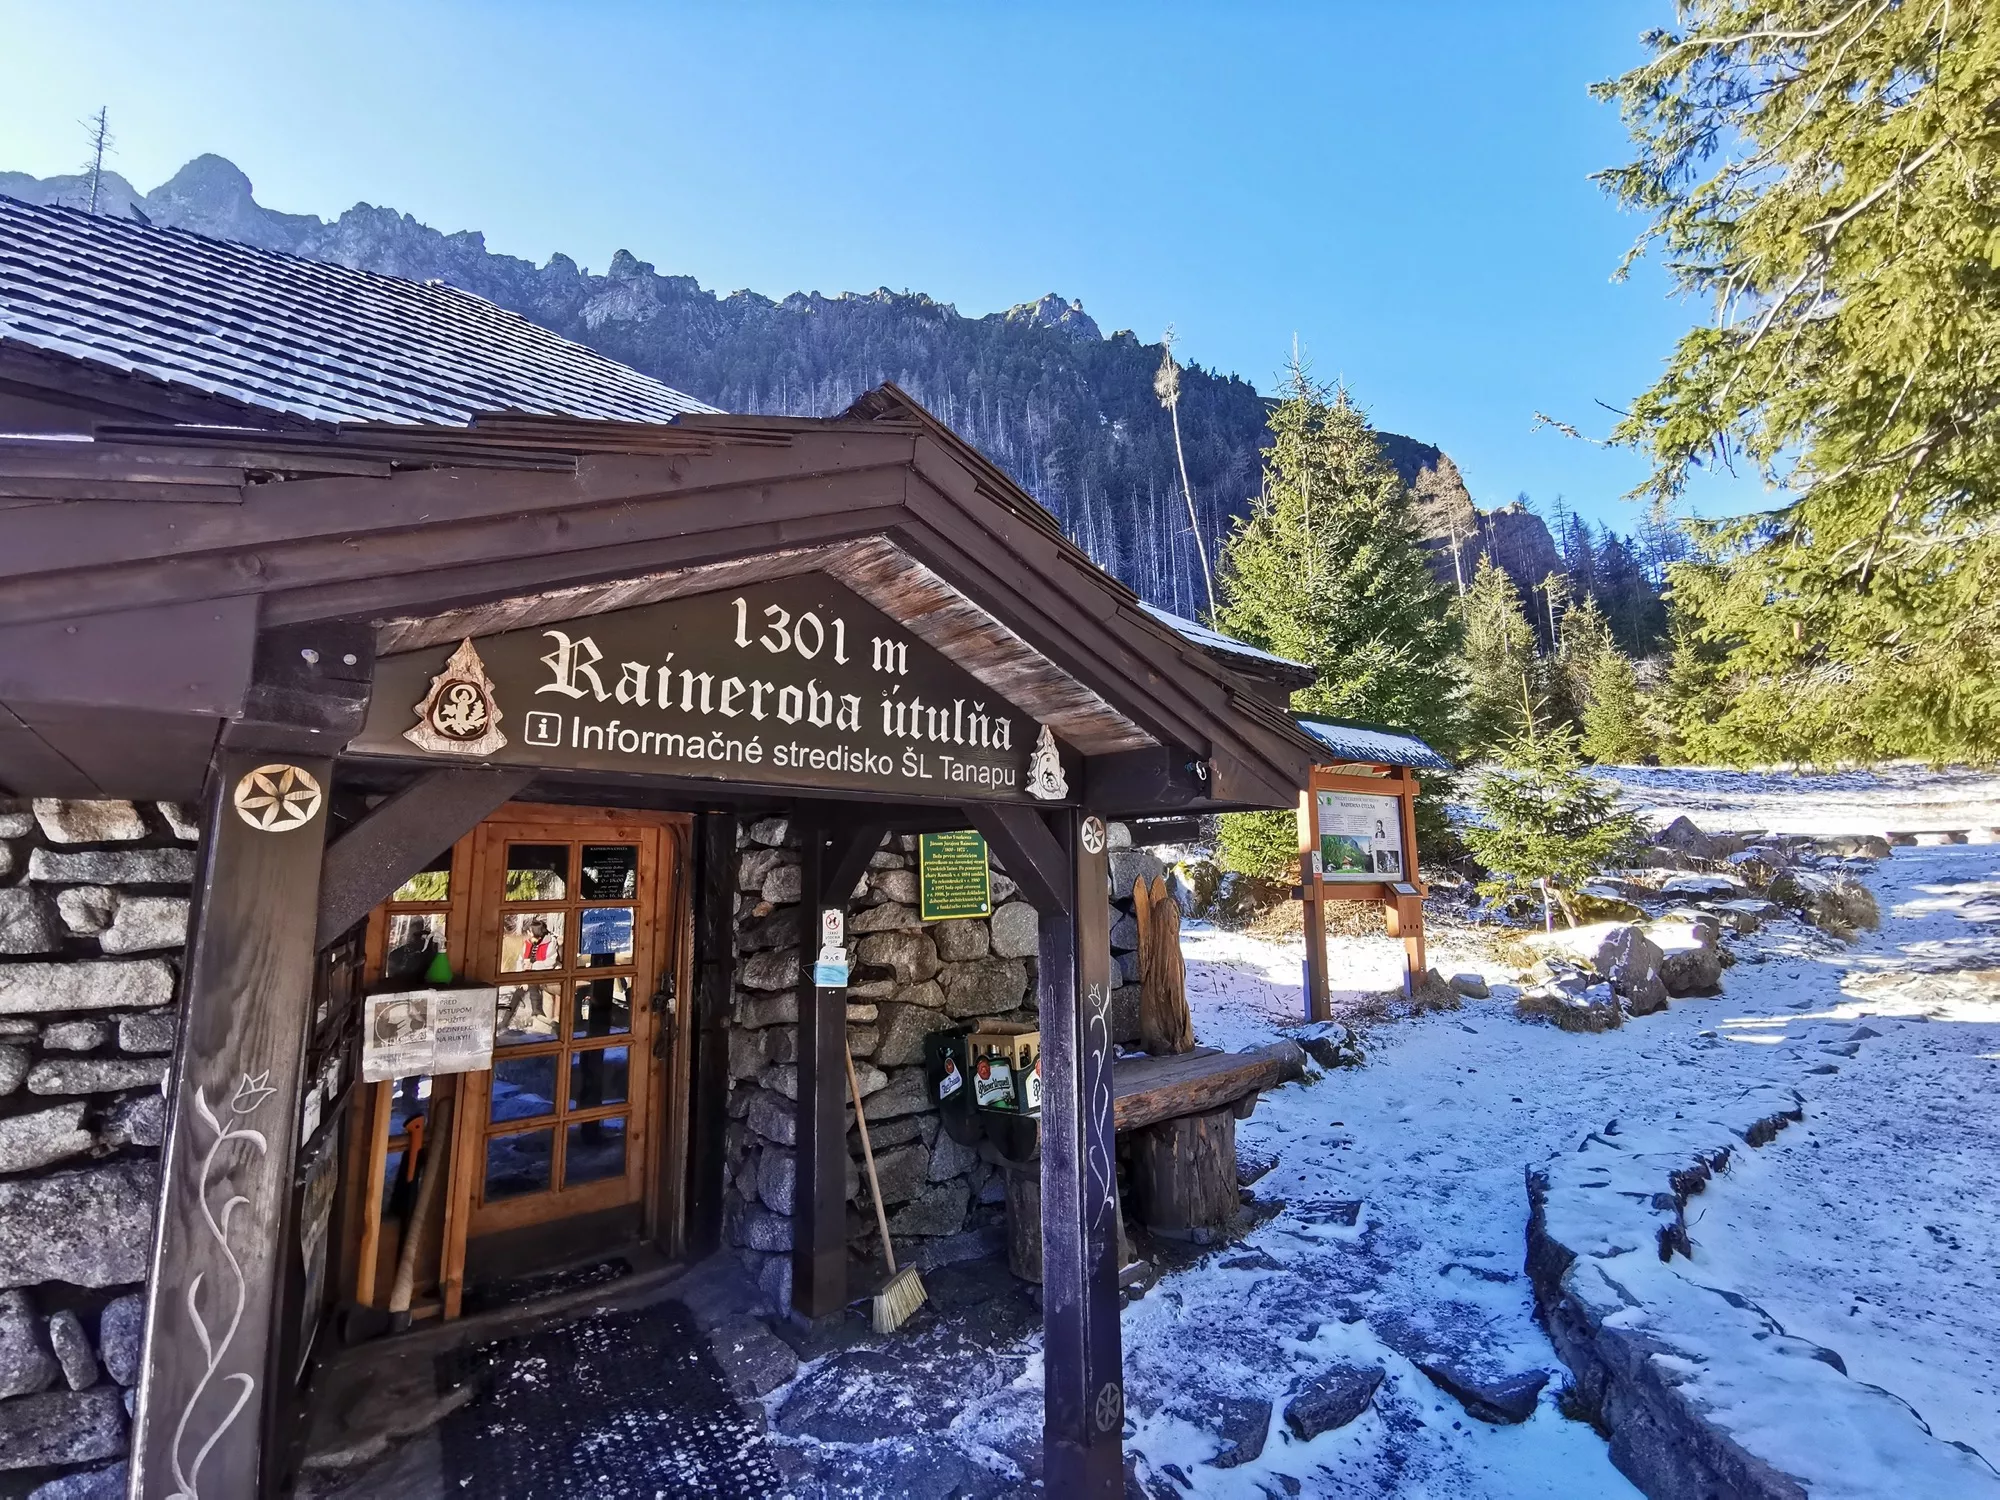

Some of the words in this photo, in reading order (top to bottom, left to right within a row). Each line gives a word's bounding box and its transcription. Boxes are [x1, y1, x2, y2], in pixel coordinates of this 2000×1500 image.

[731, 597, 849, 666] 1301
[871, 636, 909, 676] m
[534, 630, 862, 733] Rainerova
[880, 684, 1013, 751] útulňa
[572, 716, 763, 764] Informačné
[772, 740, 894, 776] stredisko
[901, 747, 933, 779] ŠL
[939, 755, 1016, 790] Tanapu
[438, 1006, 472, 1015] VSTUPOM
